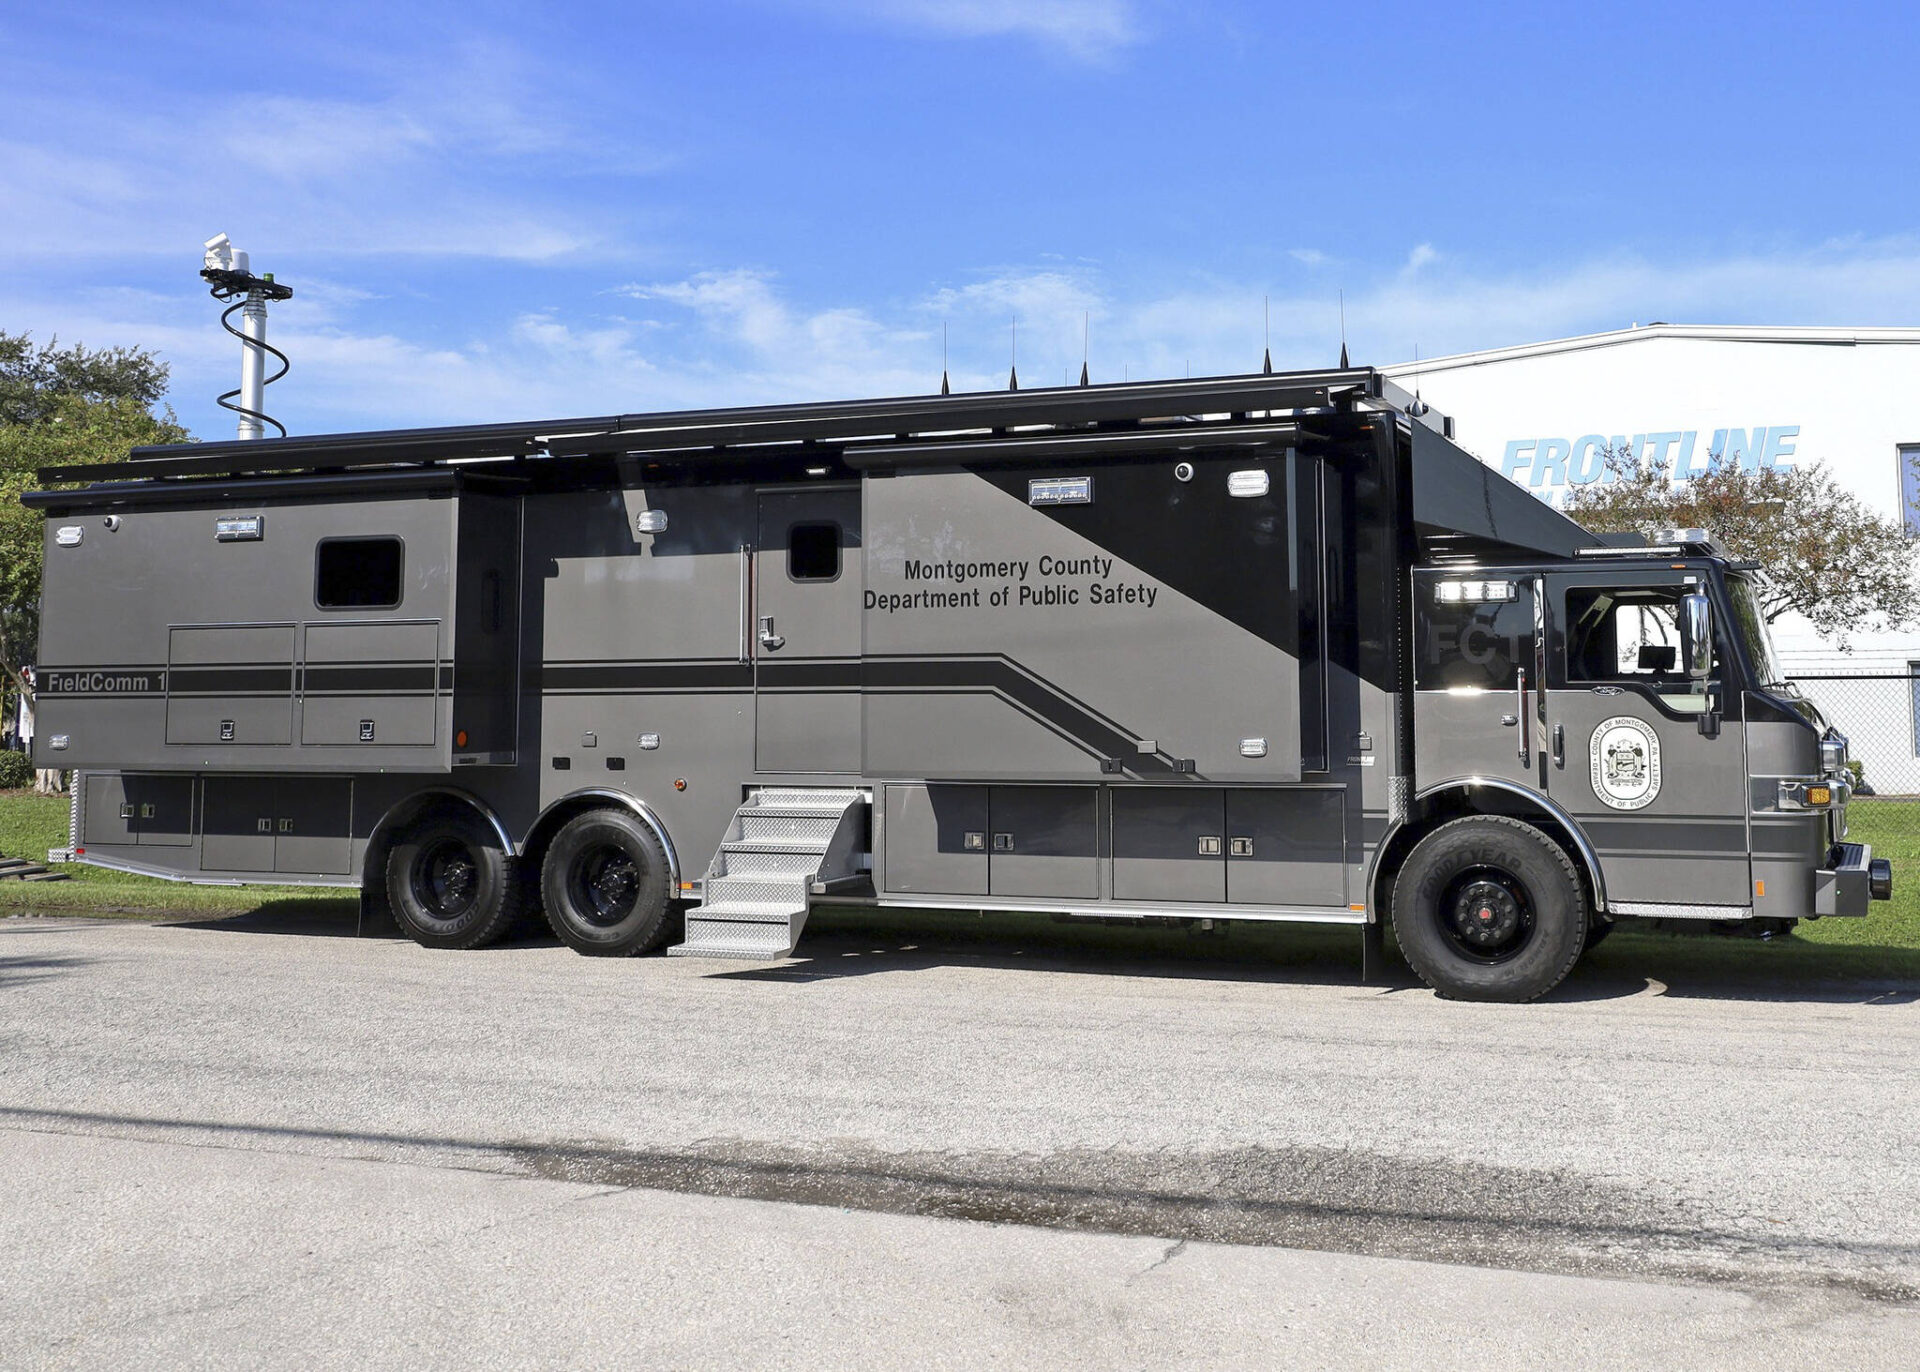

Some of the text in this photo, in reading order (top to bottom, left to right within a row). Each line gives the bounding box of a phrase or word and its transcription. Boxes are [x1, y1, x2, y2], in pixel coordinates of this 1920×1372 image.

[1501, 425, 1800, 487] FRONTLINE
[904, 555, 1113, 583] Montgomery County
[863, 582, 1157, 613] Department of Public Safety
[48, 672, 166, 692] FieldComm 1
[1592, 727, 1604, 756] COUNTY
[1604, 721, 1613, 730] OF
[1630, 792, 1654, 807] PUBLIC
[1651, 763, 1660, 791] SAFETY
